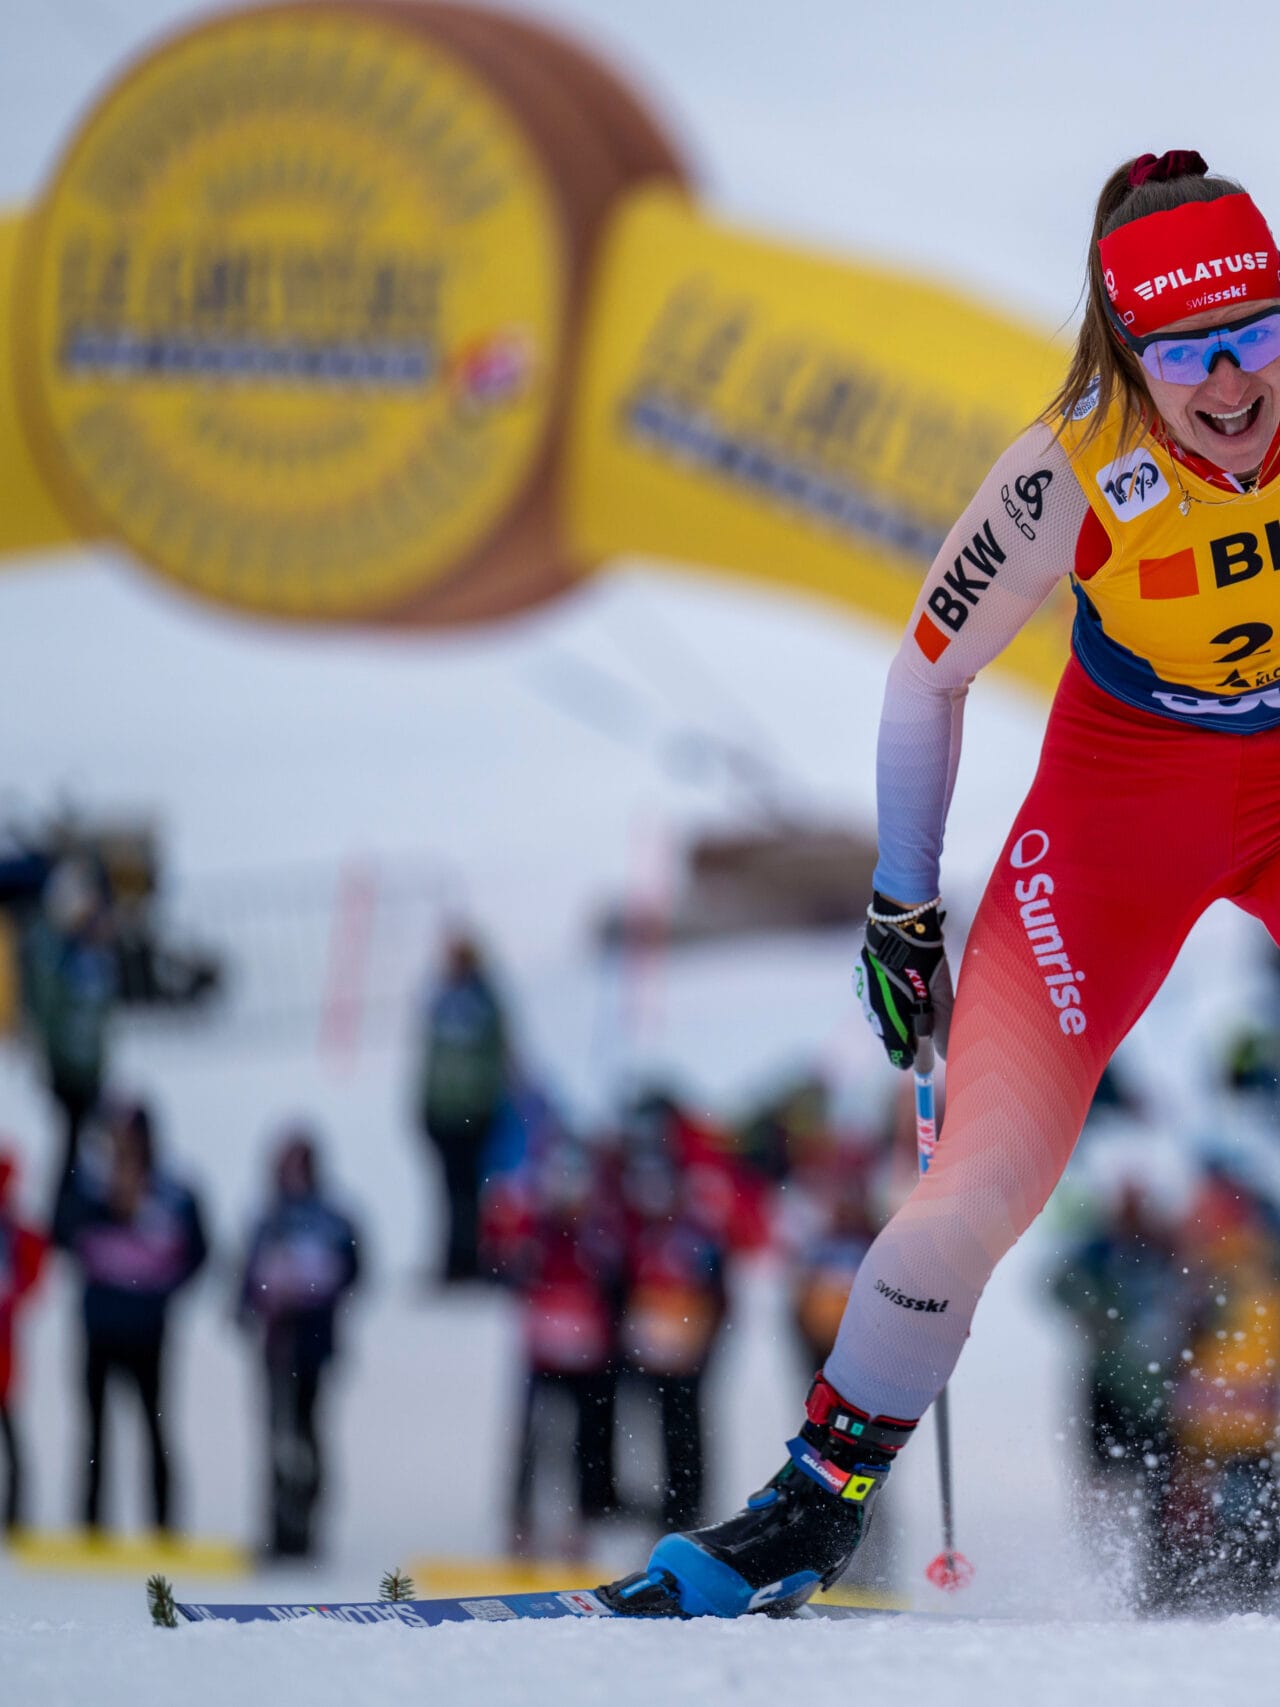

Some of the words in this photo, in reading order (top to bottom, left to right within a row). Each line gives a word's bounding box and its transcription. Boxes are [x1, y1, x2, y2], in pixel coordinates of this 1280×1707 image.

[1153, 253, 1256, 295] PILATUS
[928, 519, 1007, 632] BKW
[1014, 873, 1087, 1036] Sunrise
